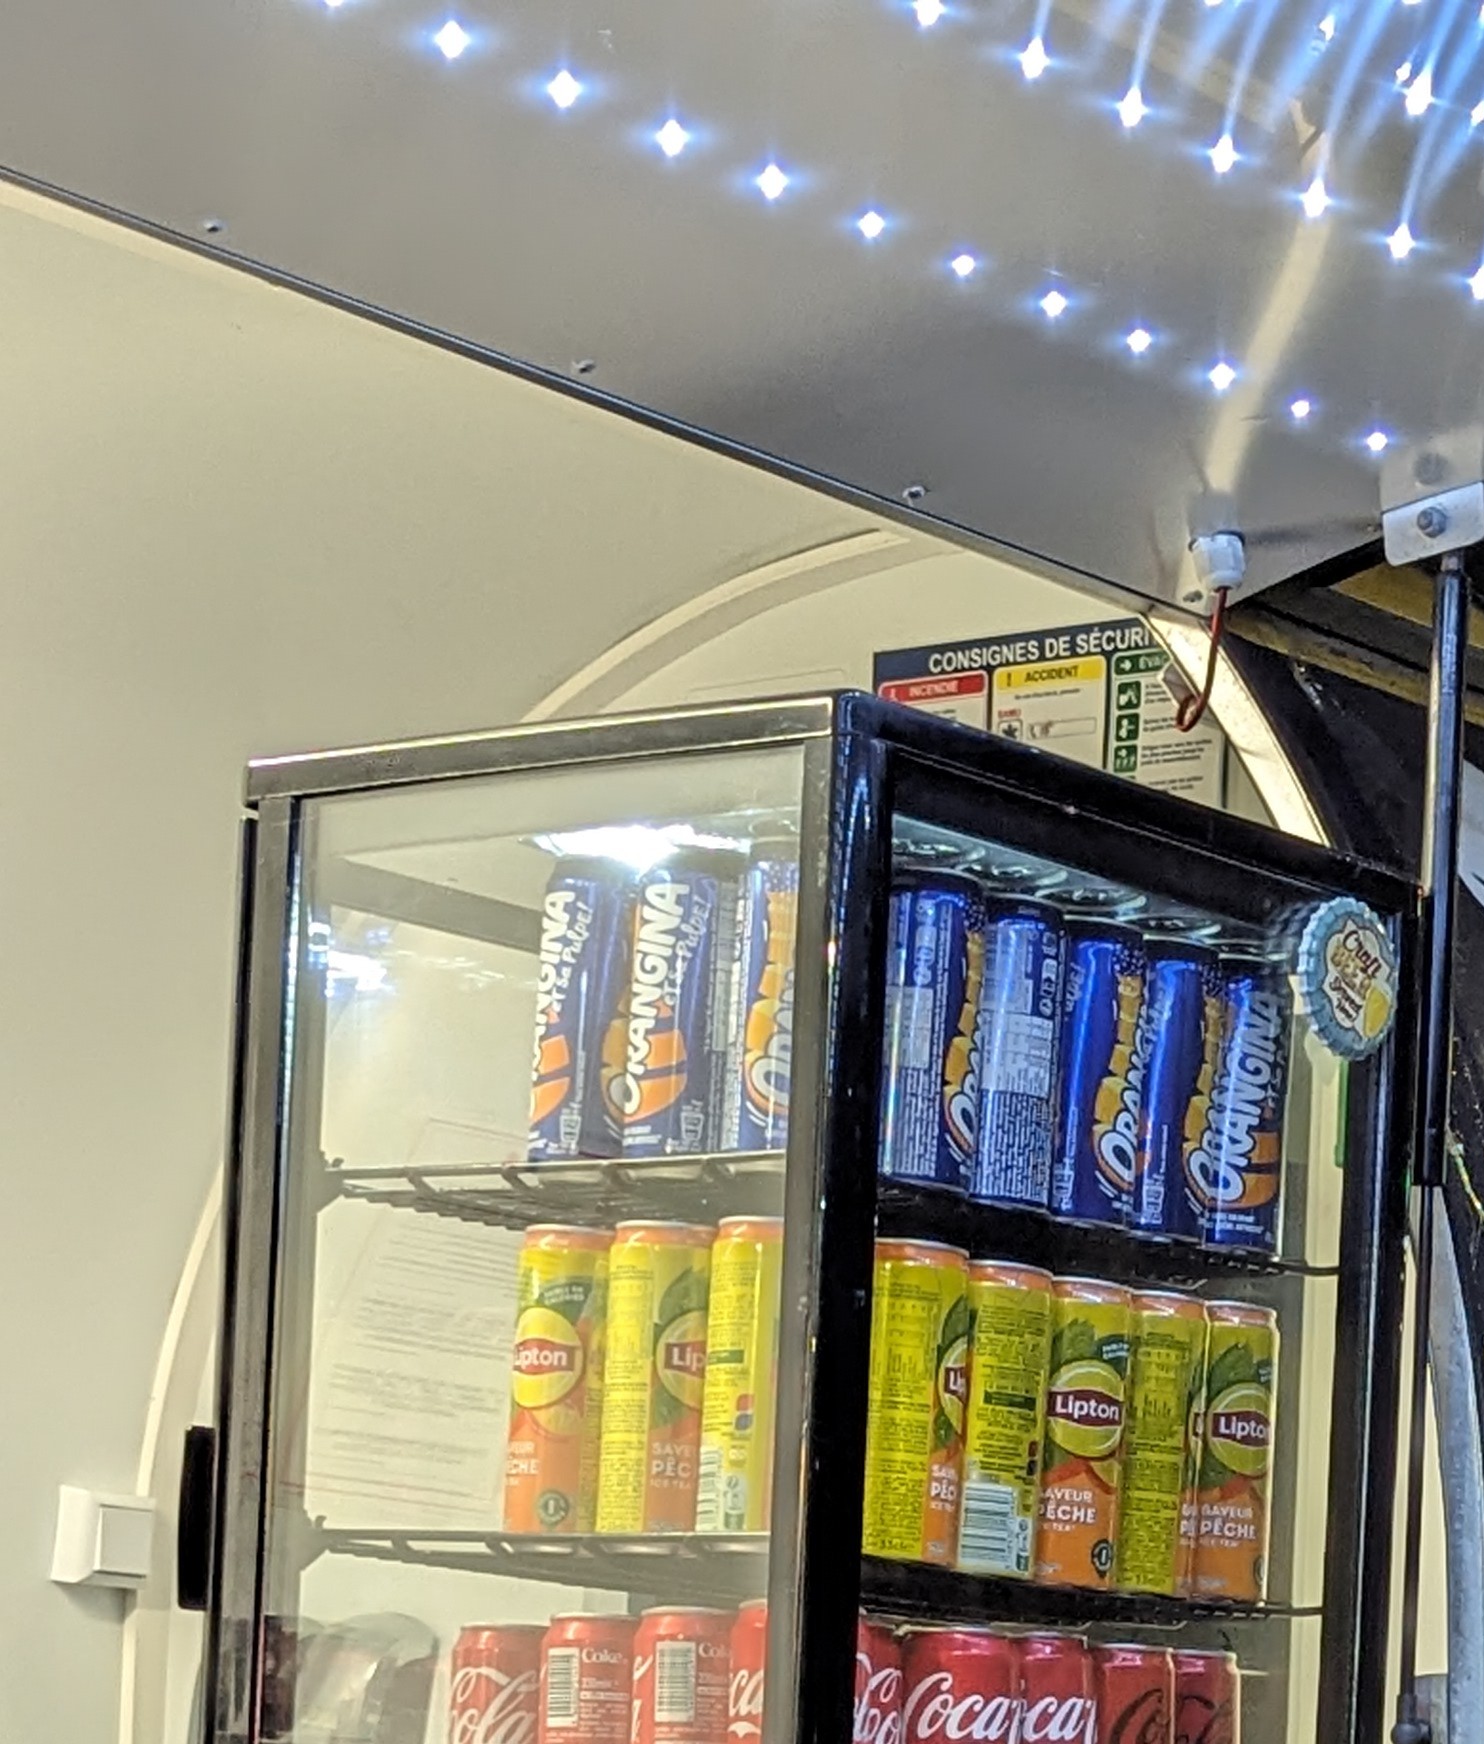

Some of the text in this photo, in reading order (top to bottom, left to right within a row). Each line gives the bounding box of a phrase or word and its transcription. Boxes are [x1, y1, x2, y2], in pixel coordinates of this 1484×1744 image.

[928, 625, 1152, 674] CONSIGNES DE SÉCURI
[1024, 665, 1079, 684] ACCIDENT
[1187, 988, 1283, 1202] ORANGINA
[671, 1346, 706, 1371] Lip
[1054, 1393, 1121, 1424] Lipton
[1218, 1415, 1269, 1442] Lipto
[651, 1456, 692, 1478] PÊC
